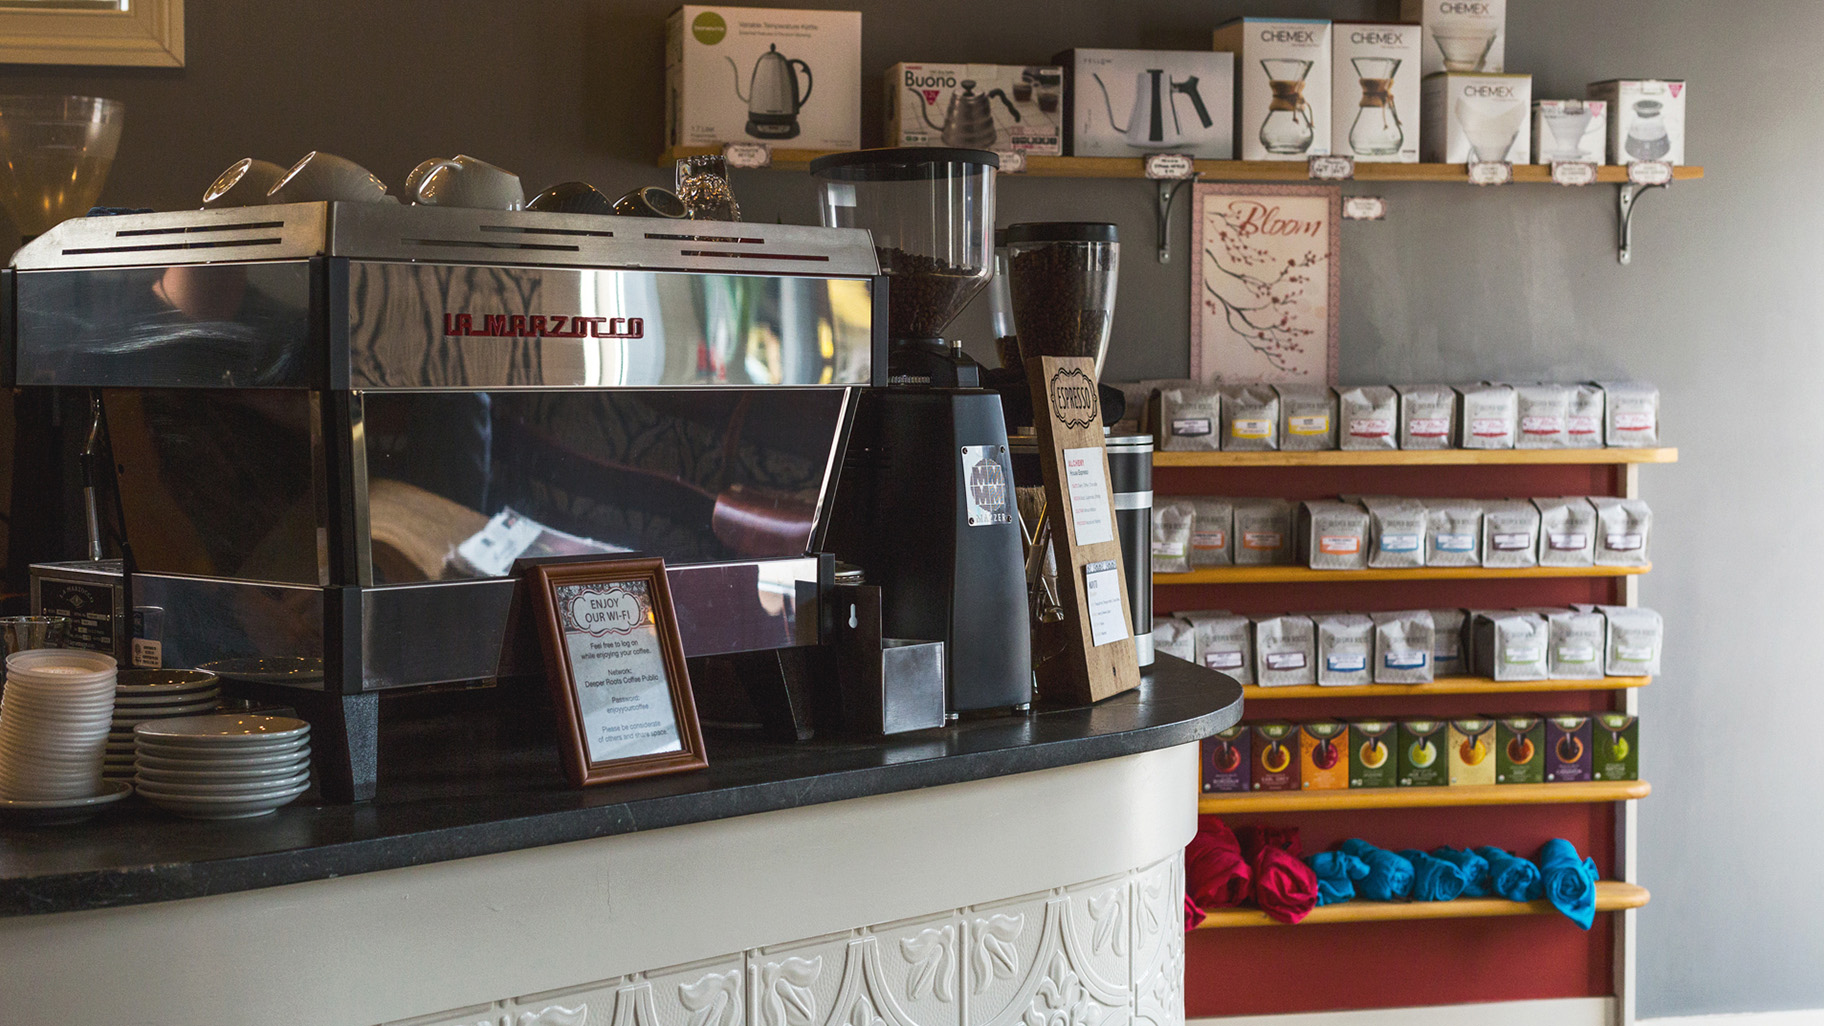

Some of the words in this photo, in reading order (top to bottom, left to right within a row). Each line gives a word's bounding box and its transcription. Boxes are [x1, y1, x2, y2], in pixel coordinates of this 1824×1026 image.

[1440, 2, 1489, 14] CHEMEX
[1260, 30, 1314, 42] CHEMEX
[1350, 32, 1402, 44] CHEMEX
[905, 70, 957, 88] Buono
[1464, 85, 1514, 97] CHEMEX
[1228, 200, 1322, 237] Bloom
[444, 313, 472, 336] LA
[484, 314, 644, 338] MARZOCCO
[1057, 387, 1091, 409] ESPRESSO
[590, 598, 619, 609] ENJOY
[585, 612, 606, 623] OUR
[606, 610, 631, 621] WI-FI
[590, 642, 602, 650] Feel
[602, 641, 614, 649] free
[621, 640, 631, 649] log
[581, 652, 596, 660] while
[596, 650, 619, 659] enjoying
[619, 649, 632, 657] your
[632, 647, 651, 655] coffee.
[607, 668, 632, 676] Network:
[584, 679, 605, 688] Deeper
[605, 678, 622, 686] Roots
[623, 676, 641, 684] Coffee
[641, 674, 658, 682] Public
[611, 695, 640, 703] Password:
[606, 703, 649, 714] enjoyyourcoffee
[602, 725, 620, 733] Please
[630, 721, 661, 731] considerate
[605, 734, 623, 742] others
[650, 729, 667, 739] space.
